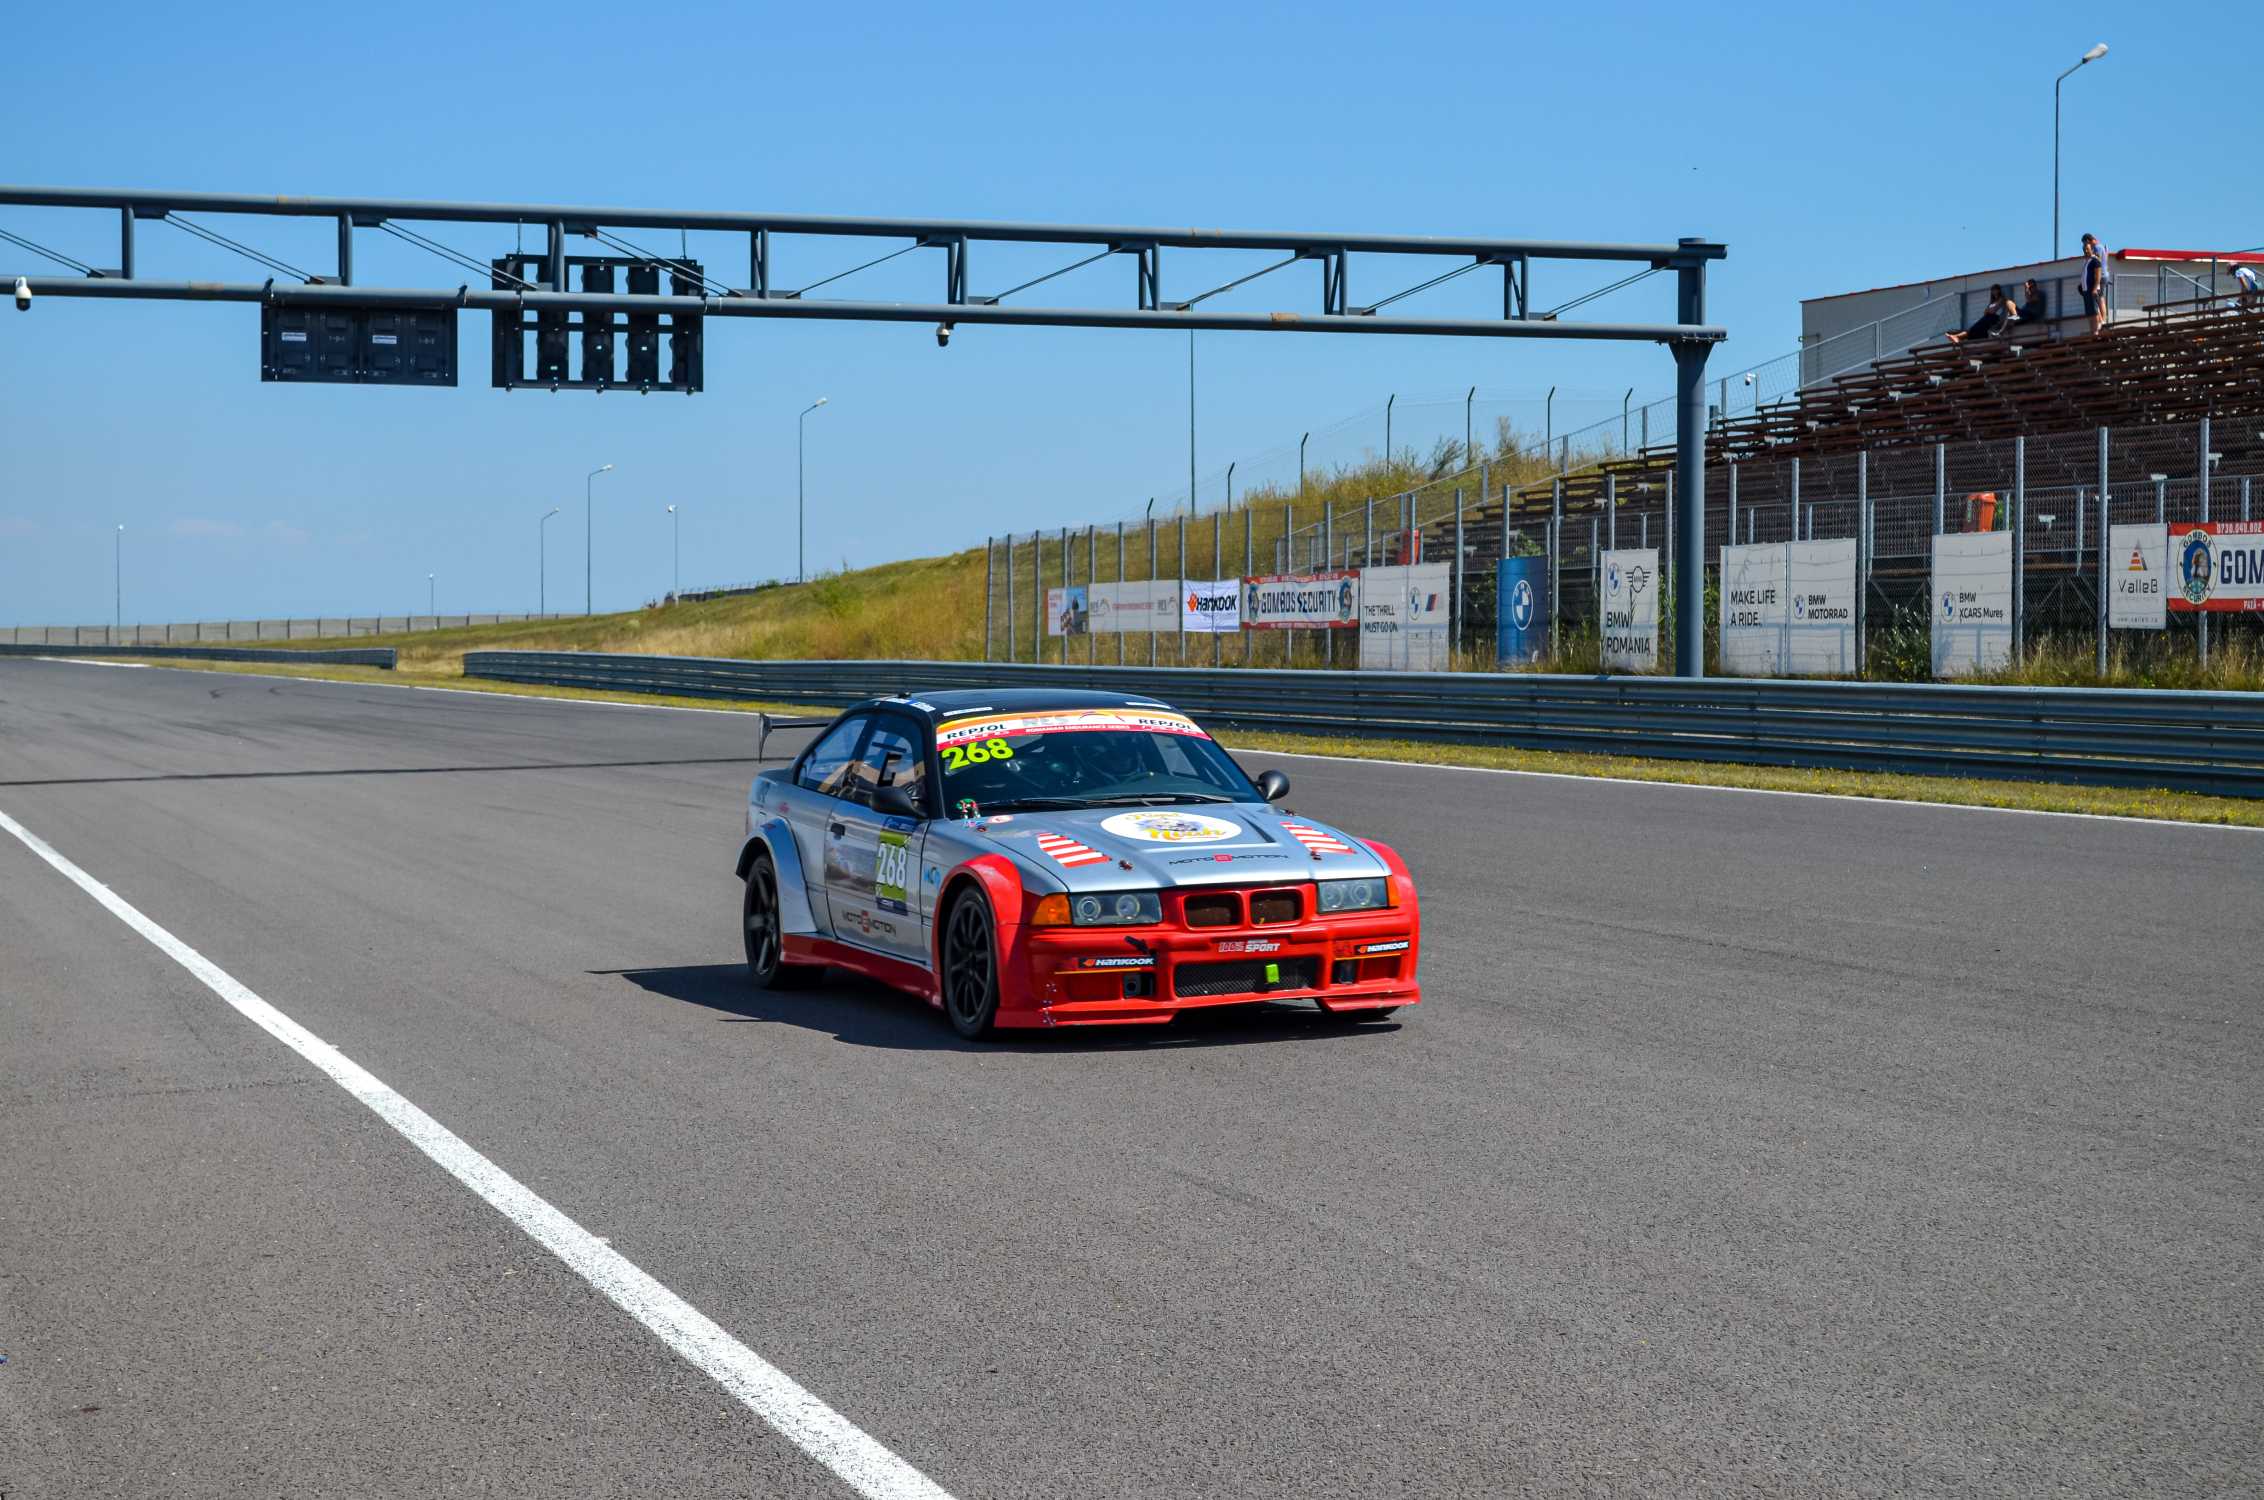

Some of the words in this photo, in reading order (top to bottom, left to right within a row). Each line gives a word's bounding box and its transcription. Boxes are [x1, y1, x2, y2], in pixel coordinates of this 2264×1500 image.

[2118, 578, 2158, 593] ValleB
[1261, 591, 1296, 614] GOMBOS
[1297, 590, 1337, 613] SECURITY
[1730, 590, 1755, 605] MAKE
[1757, 589, 1776, 604] LIFE
[1808, 594, 1827, 606] BMW
[1959, 592, 1977, 603] BMW
[1365, 605, 1377, 616] THE
[1378, 605, 1396, 616] THRILL
[1808, 608, 1848, 620] MOTORRAD
[1959, 607, 1982, 619] XCARS
[1983, 607, 2004, 618] Mures
[1606, 611, 1630, 629] BMW
[1730, 613, 1737, 626] A
[1738, 611, 1761, 626] RIDE.
[1364, 622, 1380, 633] MUST
[1380, 622, 1389, 632] GO
[1606, 636, 1651, 654] ROMANIA
[947, 724, 1007, 739] REPSOL
[1138, 719, 1191, 730] REPSOL
[942, 738, 1014, 769] 268
[877, 843, 907, 889] 268
[1245, 943, 1280, 952] SPORT
